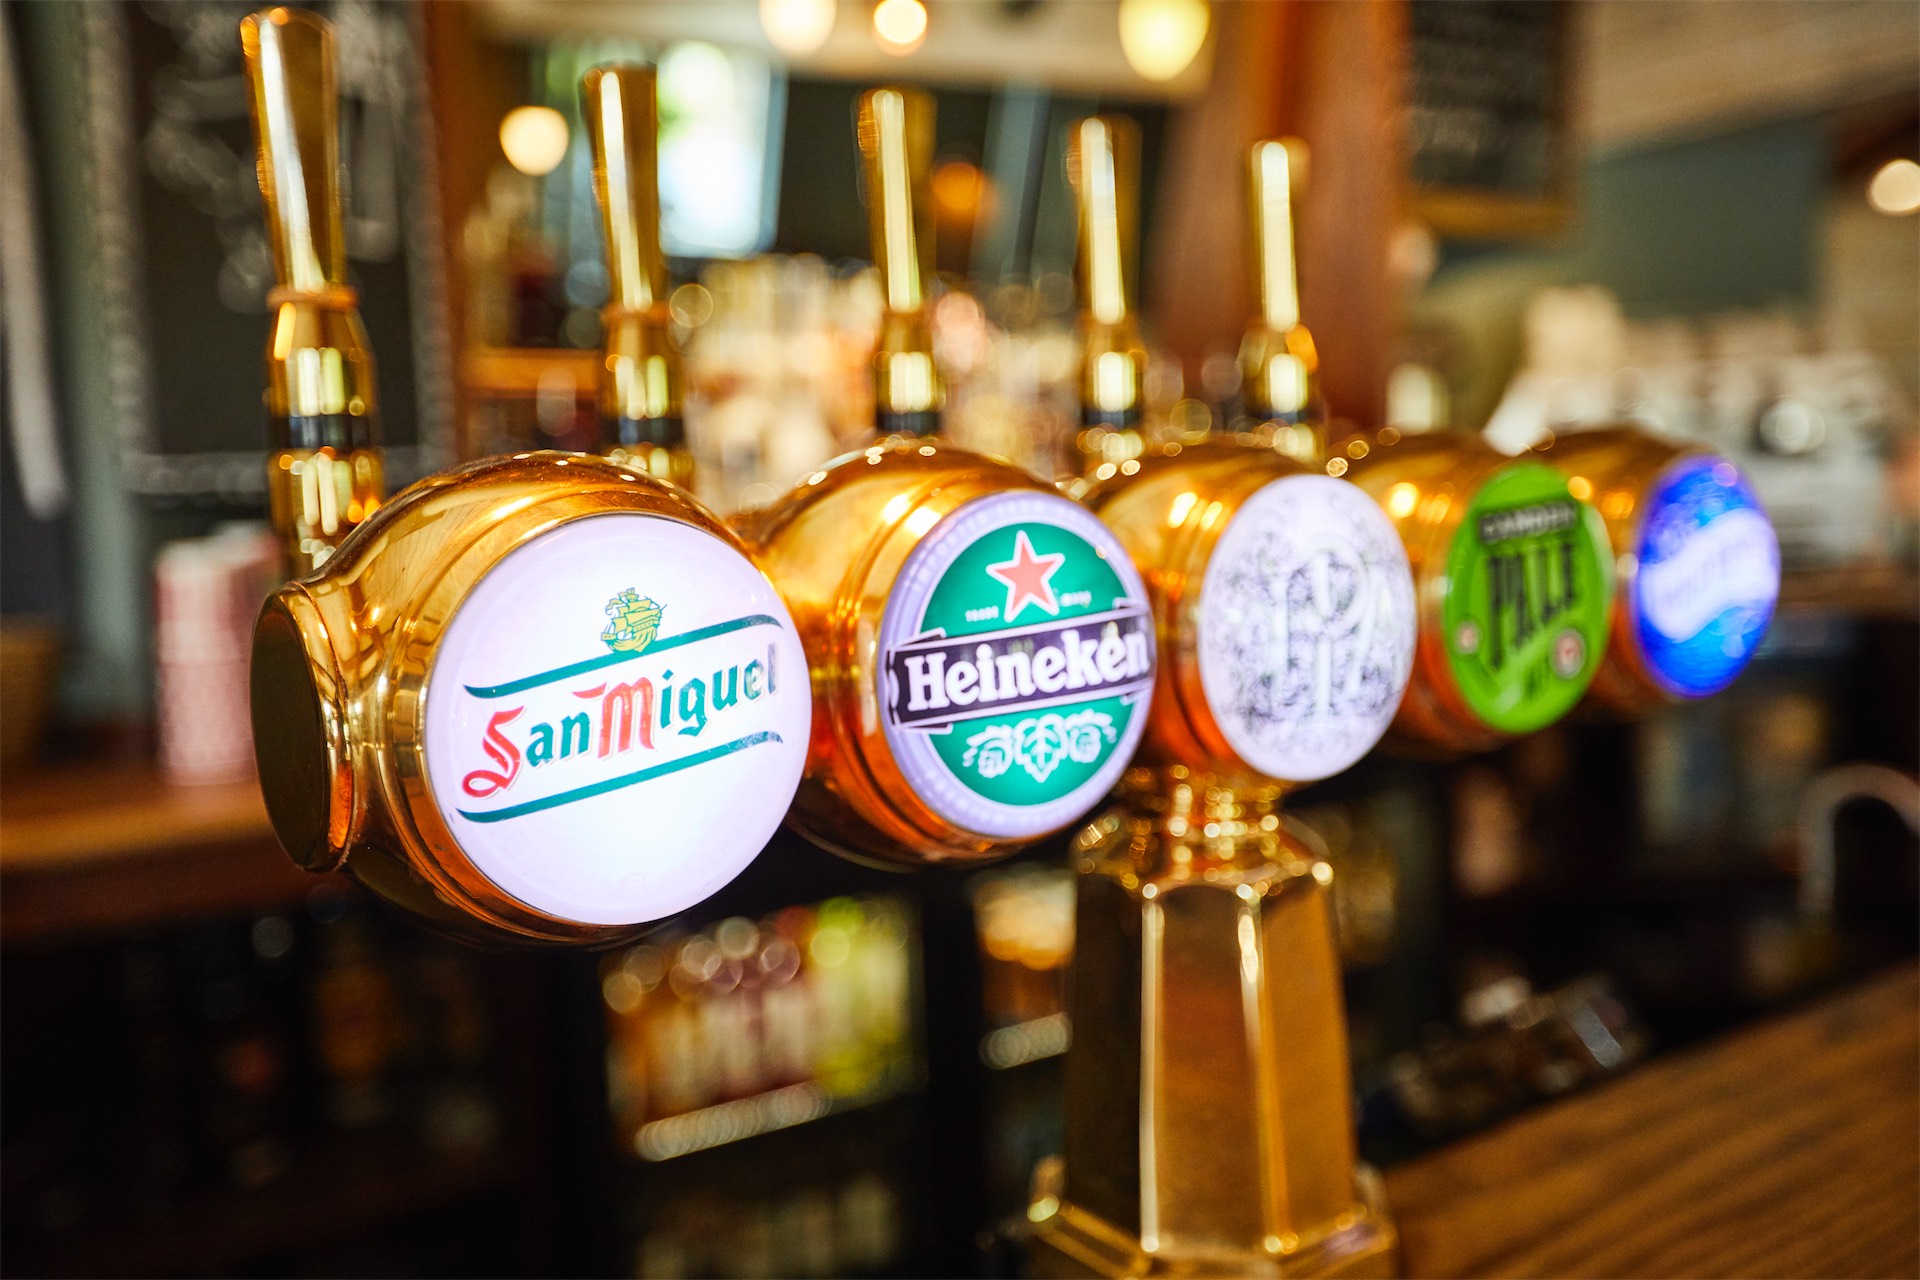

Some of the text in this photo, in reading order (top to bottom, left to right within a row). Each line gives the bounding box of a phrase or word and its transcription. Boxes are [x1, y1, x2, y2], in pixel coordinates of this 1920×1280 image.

[461, 642, 779, 798] San Miguel
[904, 629, 1150, 712] Heineken
